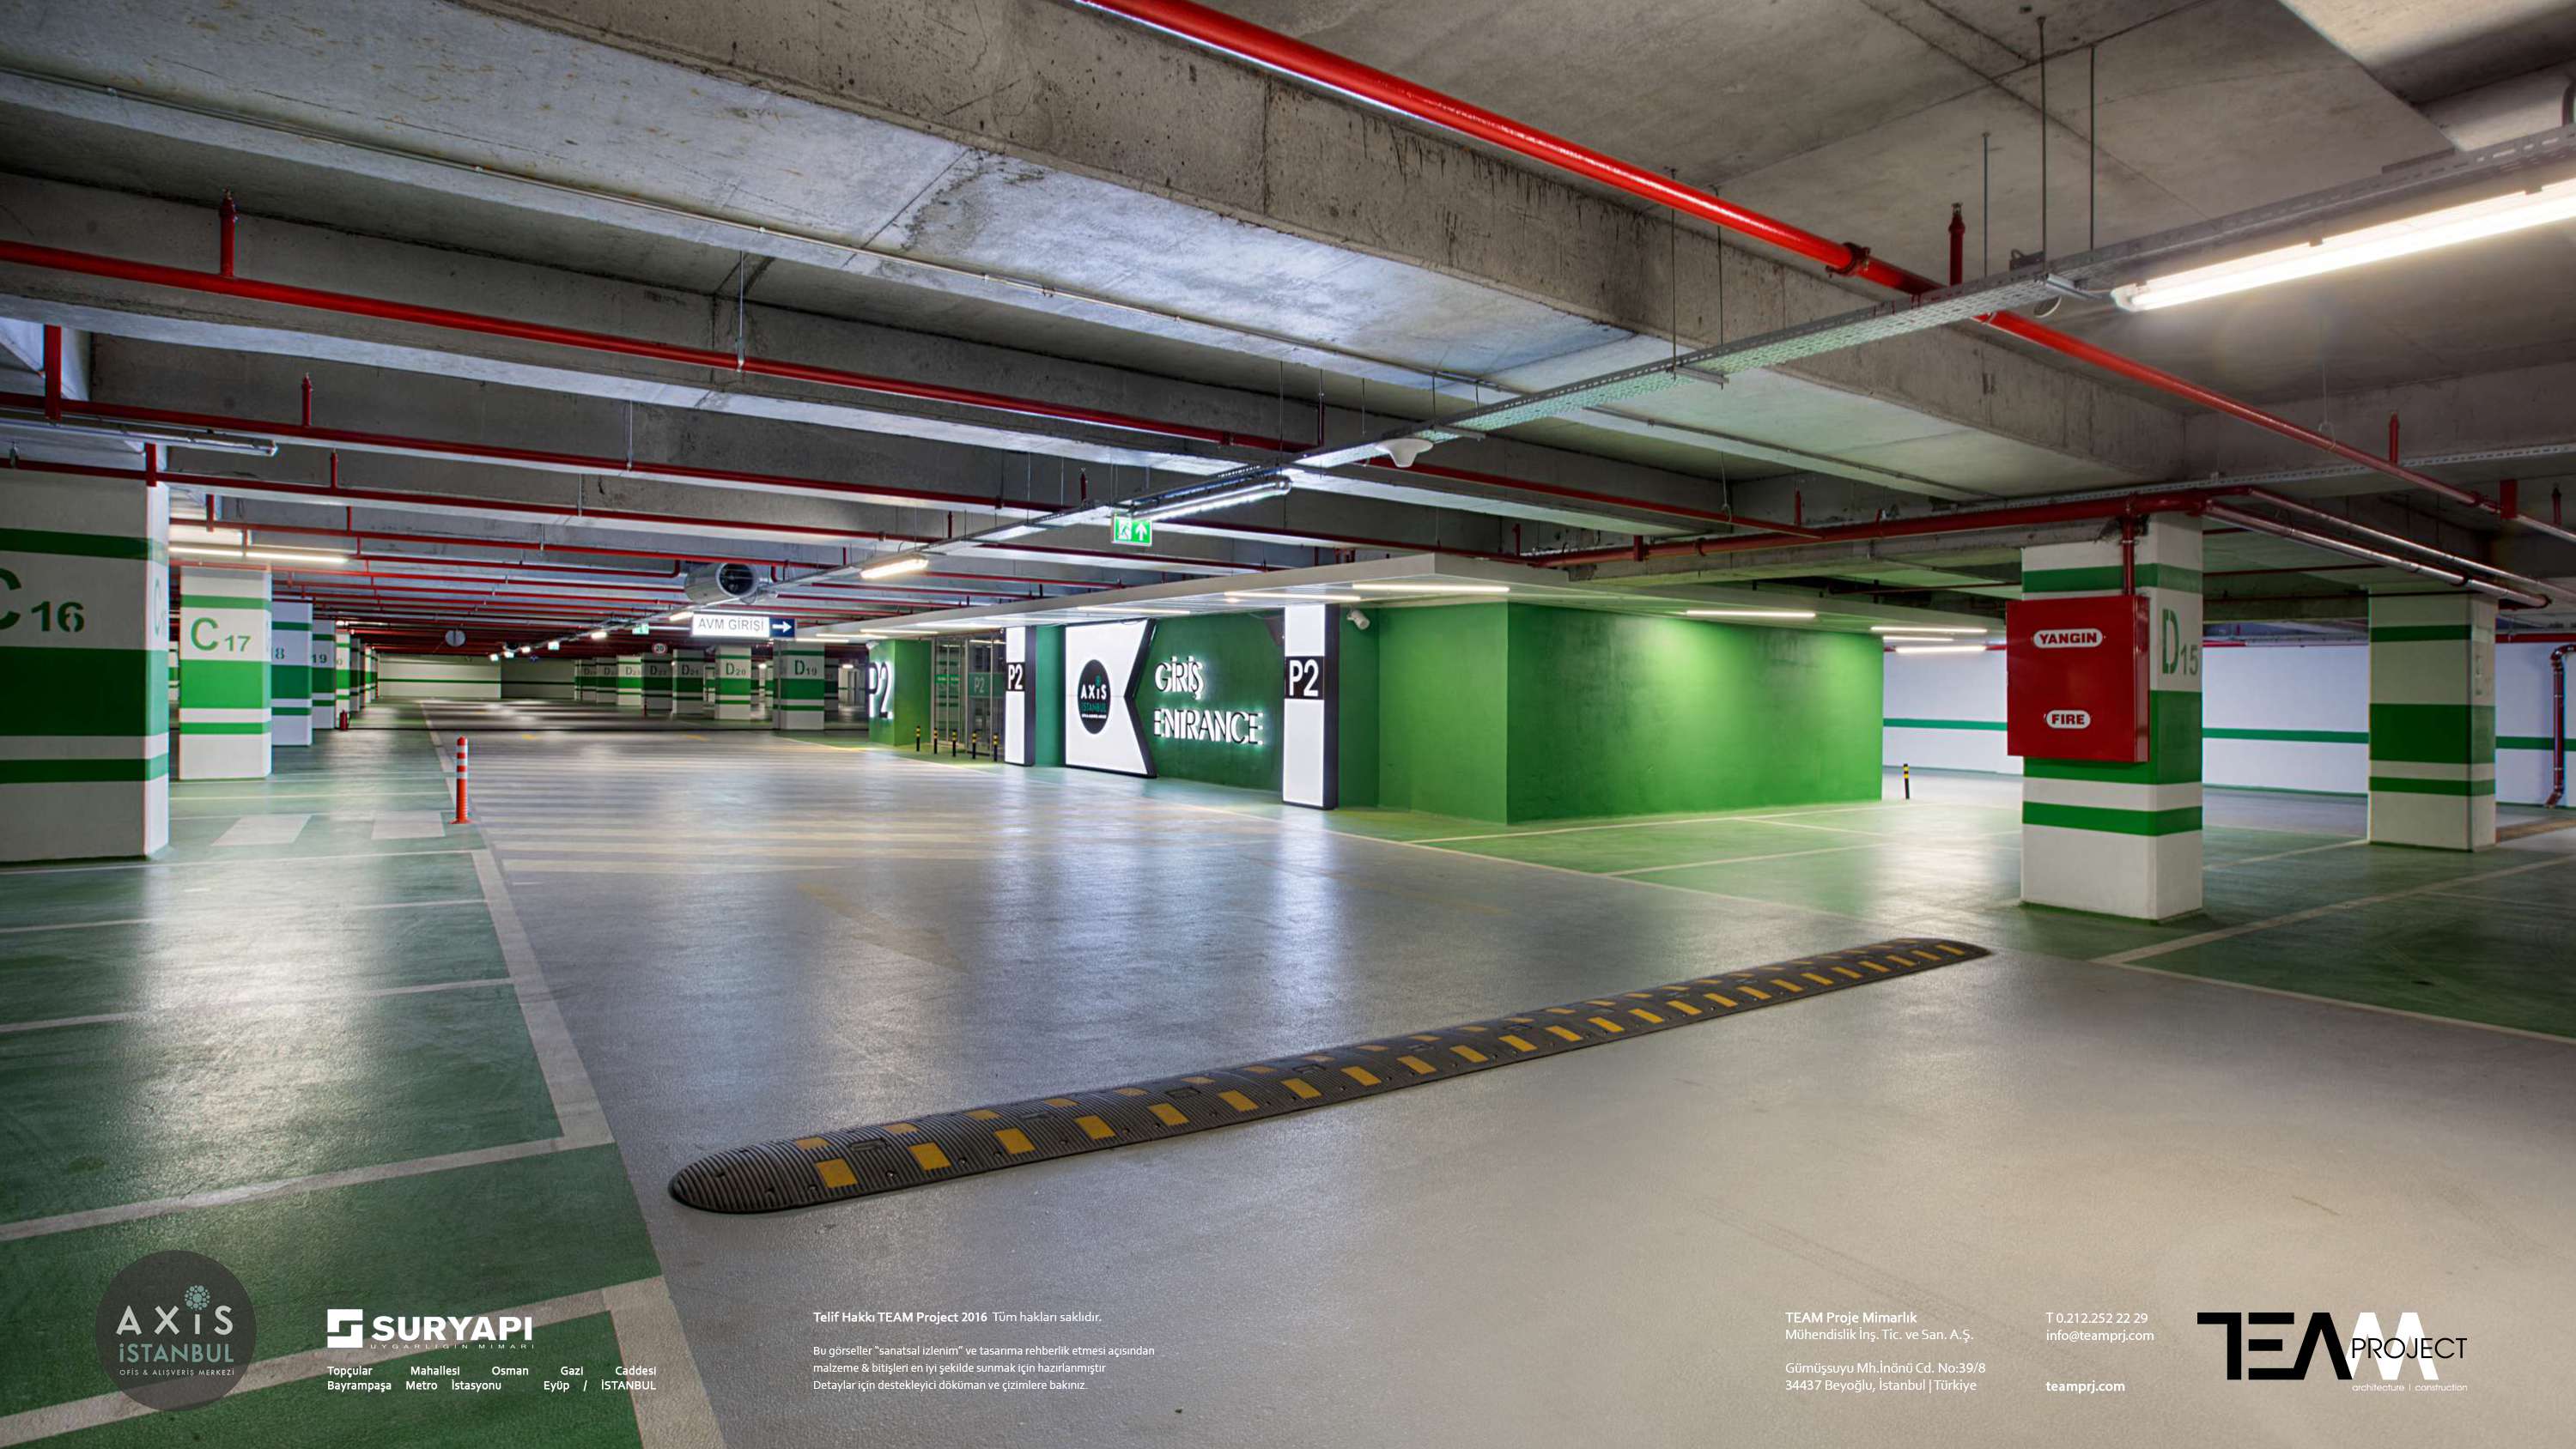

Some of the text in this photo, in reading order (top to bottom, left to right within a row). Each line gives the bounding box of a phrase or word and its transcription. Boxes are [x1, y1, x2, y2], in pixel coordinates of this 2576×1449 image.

[191, 617, 251, 652] C17
[698, 618, 723, 630] AVM
[2039, 632, 2097, 645] YANGIN
[867, 662, 894, 718] P2
[974, 676, 985, 694] P2
[1008, 664, 1023, 689] P2
[1155, 656, 1204, 700] GİRİŞ
[1289, 658, 1319, 696] P2
[1154, 708, 1263, 745] ENTRANCE
[2051, 714, 2085, 725] FIRE
